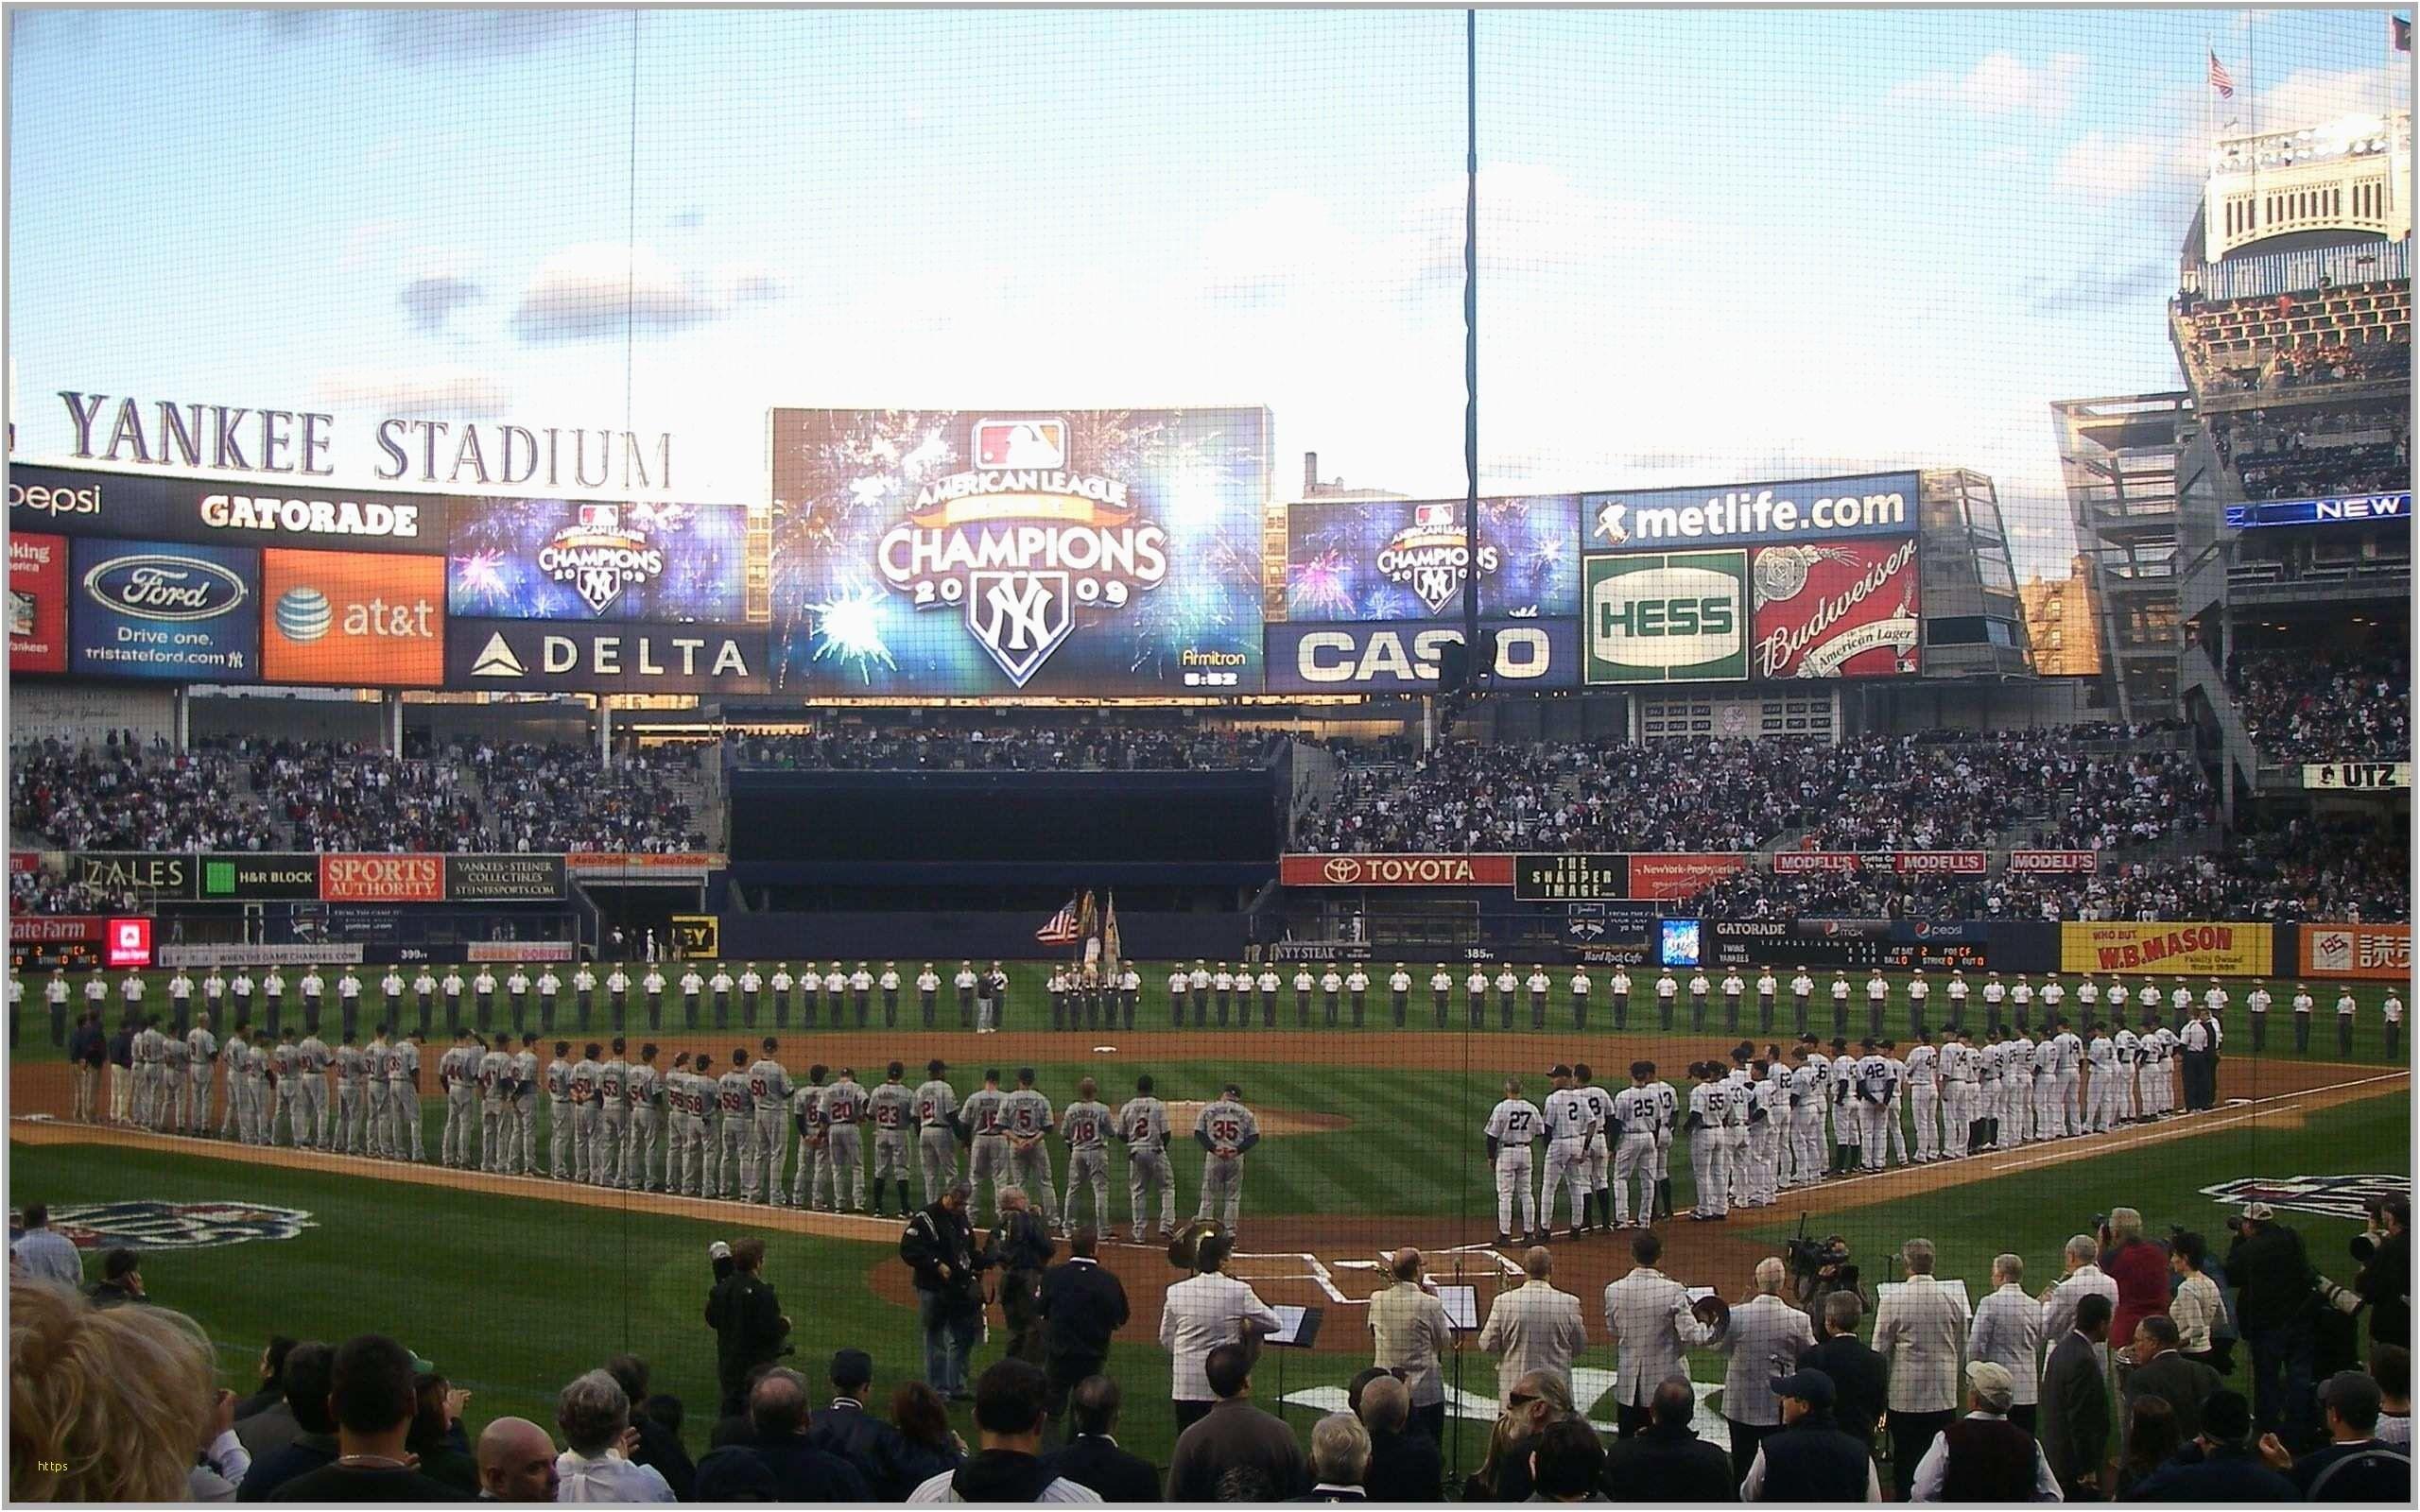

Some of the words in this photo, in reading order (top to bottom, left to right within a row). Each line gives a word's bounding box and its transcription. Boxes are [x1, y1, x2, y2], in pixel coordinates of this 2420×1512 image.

[58, 390, 334, 474] YANKEE
[374, 418, 675, 490] STADIUM
[914, 471, 1039, 511] AMERICAN
[1043, 472, 1128, 508] LEAGUE
[200, 493, 419, 537] GATORADE
[1636, 490, 1905, 539] metlife.com
[2316, 497, 2400, 519] NEW
[539, 548, 664, 575] CHAMPIONS
[878, 525, 1167, 584] CHAMPIONS
[123, 568, 210, 608] Ford
[914, 580, 962, 603] 20
[1077, 579, 1129, 604] 09
[343, 597, 434, 638] at&t
[1600, 596, 1732, 638] HESS
[1754, 538, 1917, 679] Budweiser
[118, 627, 167, 644] Drive
[174, 632, 214, 646] one.
[85, 646, 224, 665] tristateford.com
[544, 635, 749, 677] DELTA
[1183, 649, 1246, 666] Armitron
[1298, 627, 1550, 682] CASO
[1818, 630, 1873, 669] American
[1877, 627, 1912, 641] Lager
[2343, 764, 2396, 786] UTZ
[330, 859, 437, 882] SPORTS
[1366, 859, 1475, 881] TOYOTA
[1557, 857, 1587, 869] THE
[1781, 855, 1852, 870] MODELL'S
[1904, 854, 1979, 869] MODELL'S
[2014, 854, 2094, 868] MODELL'S
[87, 860, 183, 886] ZALES
[239, 870, 267, 883] H&R
[271, 871, 313, 883] BLOCK
[468, 872, 543, 883] COLLECTIBLES
[1532, 870, 1612, 884] SHARPER
[1717, 922, 1786, 936] GATORADE
[1931, 925, 1962, 937] pepsi
[2092, 931, 2116, 941] WHO
[2118, 930, 2137, 940] BUT
[1301, 947, 1336, 959] STEAK
[1584, 952, 1605, 961] Hard
[1624, 952, 1643, 964] Cafe
[1720, 954, 1750, 963] YANKEES
[1921, 947, 1927, 956] 2
[1865, 1063, 1885, 1079] 42
[603, 1080, 618, 1097] 53
[722, 1091, 740, 1109] 59
[1634, 1099, 1654, 1118] 25
[1658, 1091, 1672, 1109] 13
[1708, 1092, 1724, 1111] 55
[831, 1101, 853, 1120] 20
[878, 1105, 900, 1124] 23
[1019, 1108, 1032, 1128] 5
[1509, 1110, 1531, 1130] 27
[1568, 1102, 1578, 1121] 2
[1071, 1121, 1095, 1143] 18
[1134, 1117, 1149, 1138] 2
[1213, 1119, 1239, 1141] 35
